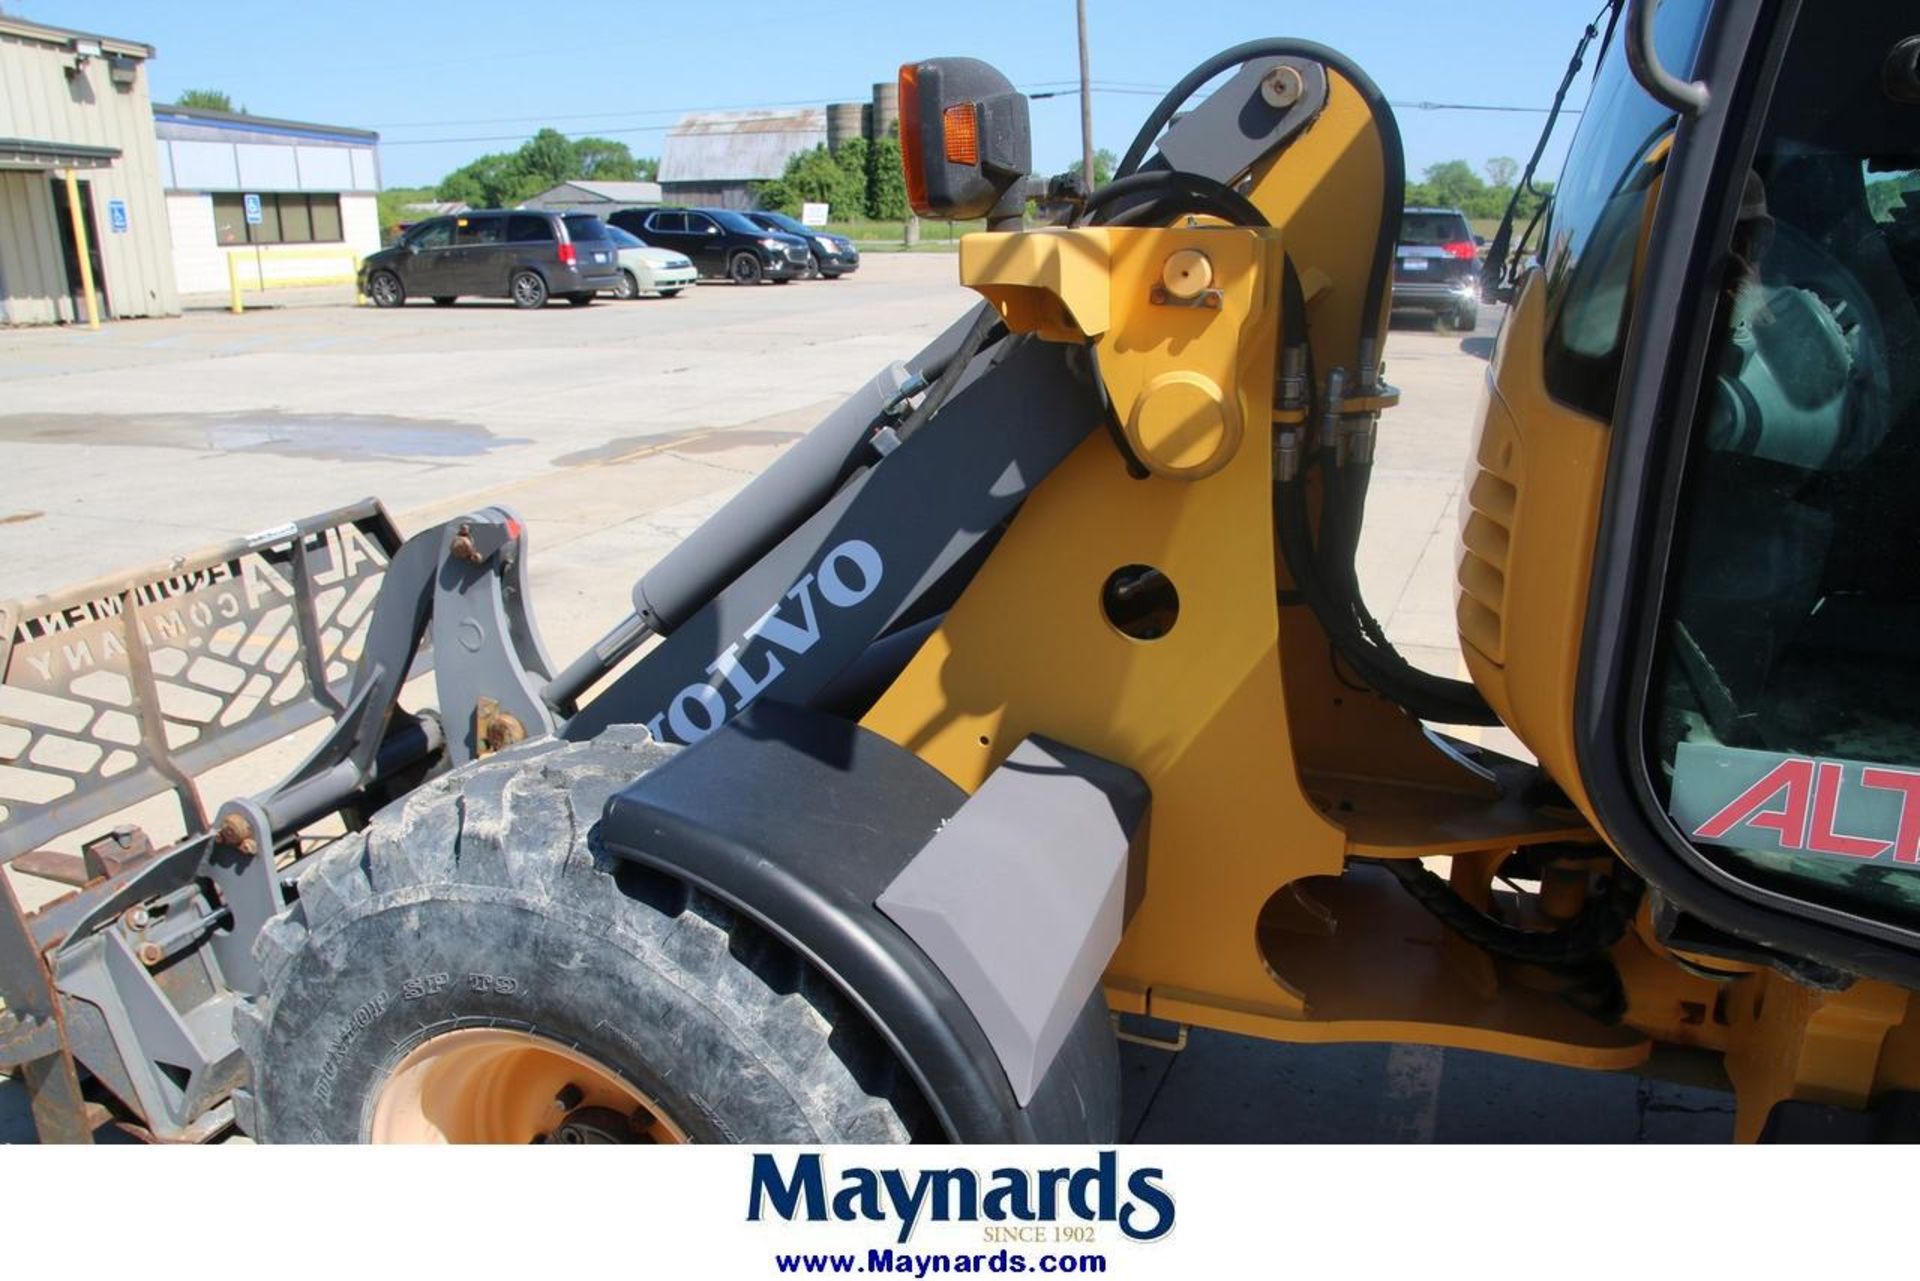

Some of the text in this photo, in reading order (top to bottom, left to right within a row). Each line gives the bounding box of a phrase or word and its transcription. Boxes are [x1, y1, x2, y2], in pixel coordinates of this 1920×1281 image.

[1692, 758, 1920, 863] ALT
[402, 972, 449, 1000] SP
[468, 972, 519, 995] T9
